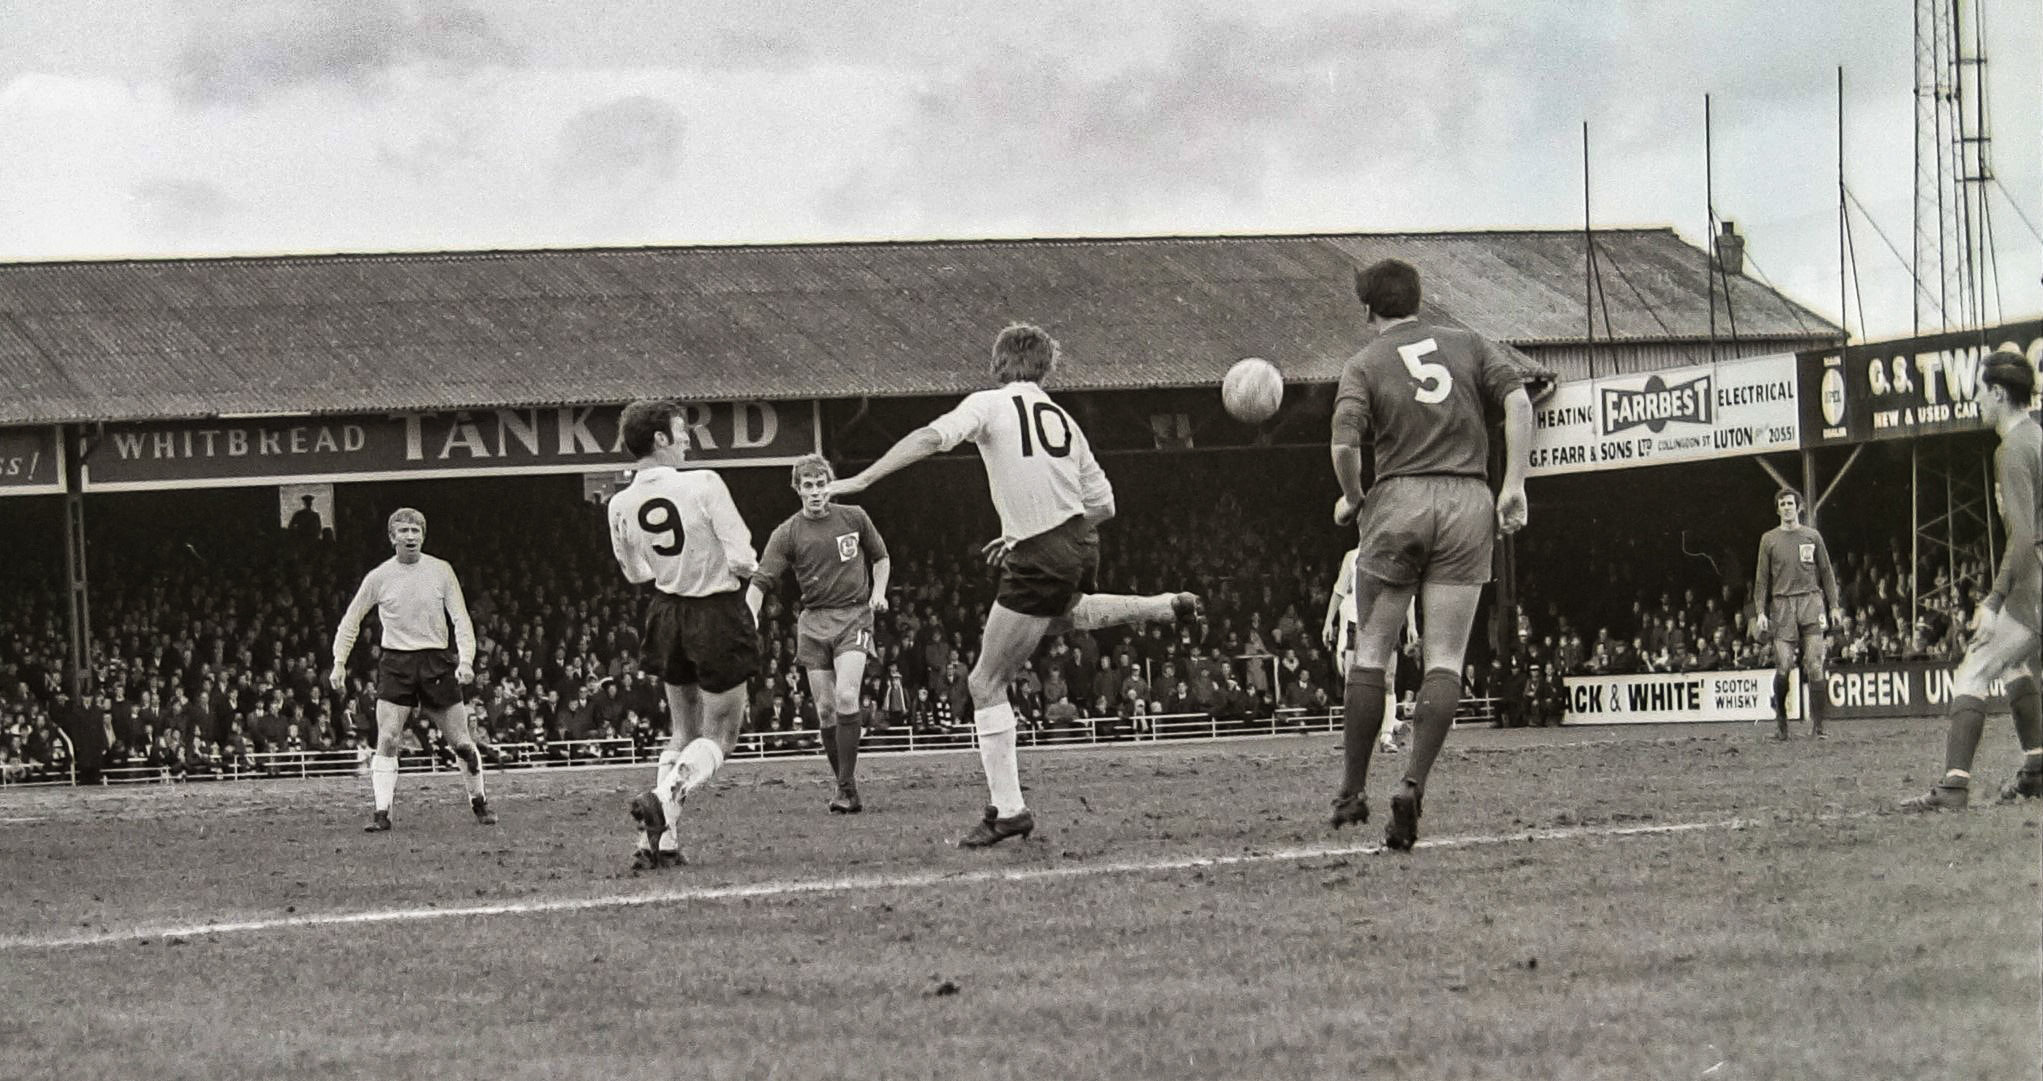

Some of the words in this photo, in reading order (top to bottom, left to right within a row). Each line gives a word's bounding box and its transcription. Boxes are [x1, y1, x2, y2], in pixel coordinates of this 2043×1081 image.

[1397, 338, 1453, 404] 5
[1605, 377, 1709, 432] FARRBEST
[1717, 381, 1794, 407] ELECTRICAL
[1918, 404, 1949, 423] USED
[113, 425, 366, 460] WHITBREAD
[388, 401, 778, 460] TANKRD
[1012, 395, 1072, 458] 10
[1552, 445, 1586, 465] FARR
[1601, 441, 1633, 461] SONS
[1714, 426, 1753, 449] LUTON
[638, 498, 685, 557] 9
[1609, 683, 1621, 713] &
[1714, 679, 1758, 694] SCOTCH
[1714, 695, 1759, 709] WHISKY
